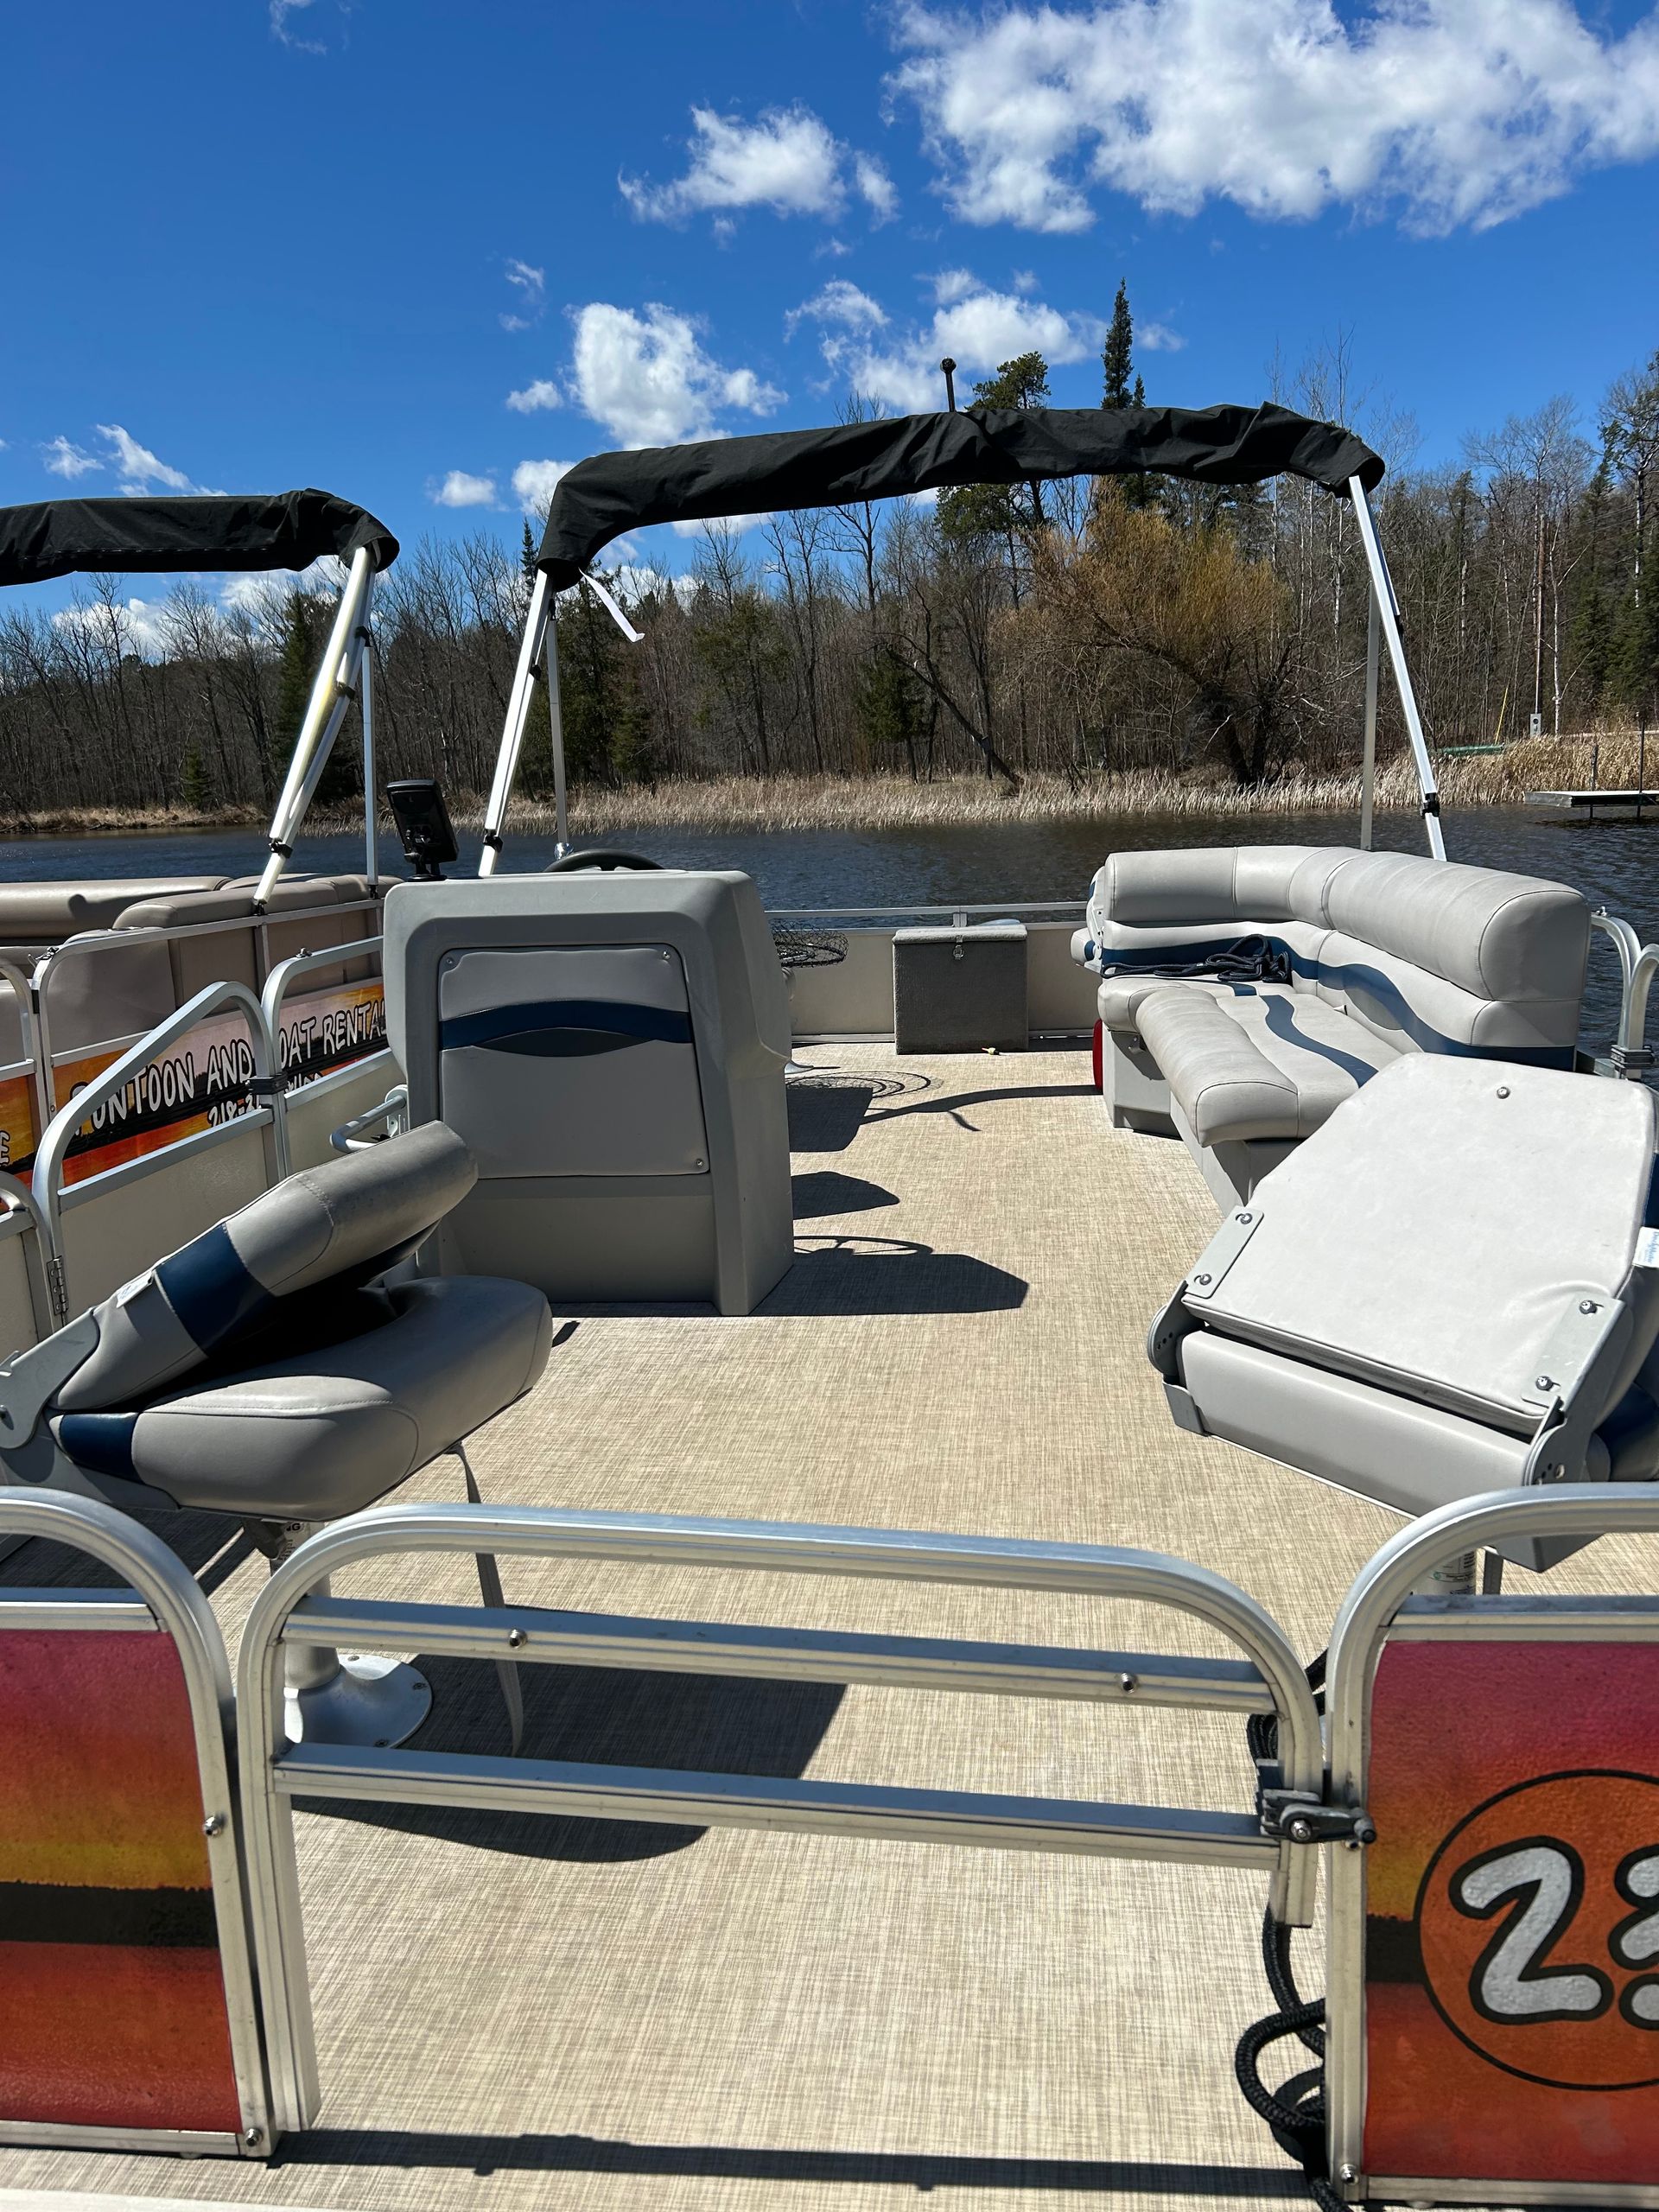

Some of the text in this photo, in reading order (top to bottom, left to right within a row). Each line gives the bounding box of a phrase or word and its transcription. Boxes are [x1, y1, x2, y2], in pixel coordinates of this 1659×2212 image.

[70, 1052, 195, 1137] ONTOON
[207, 1039, 253, 1095] AND
[278, 1015, 317, 1070] OAT
